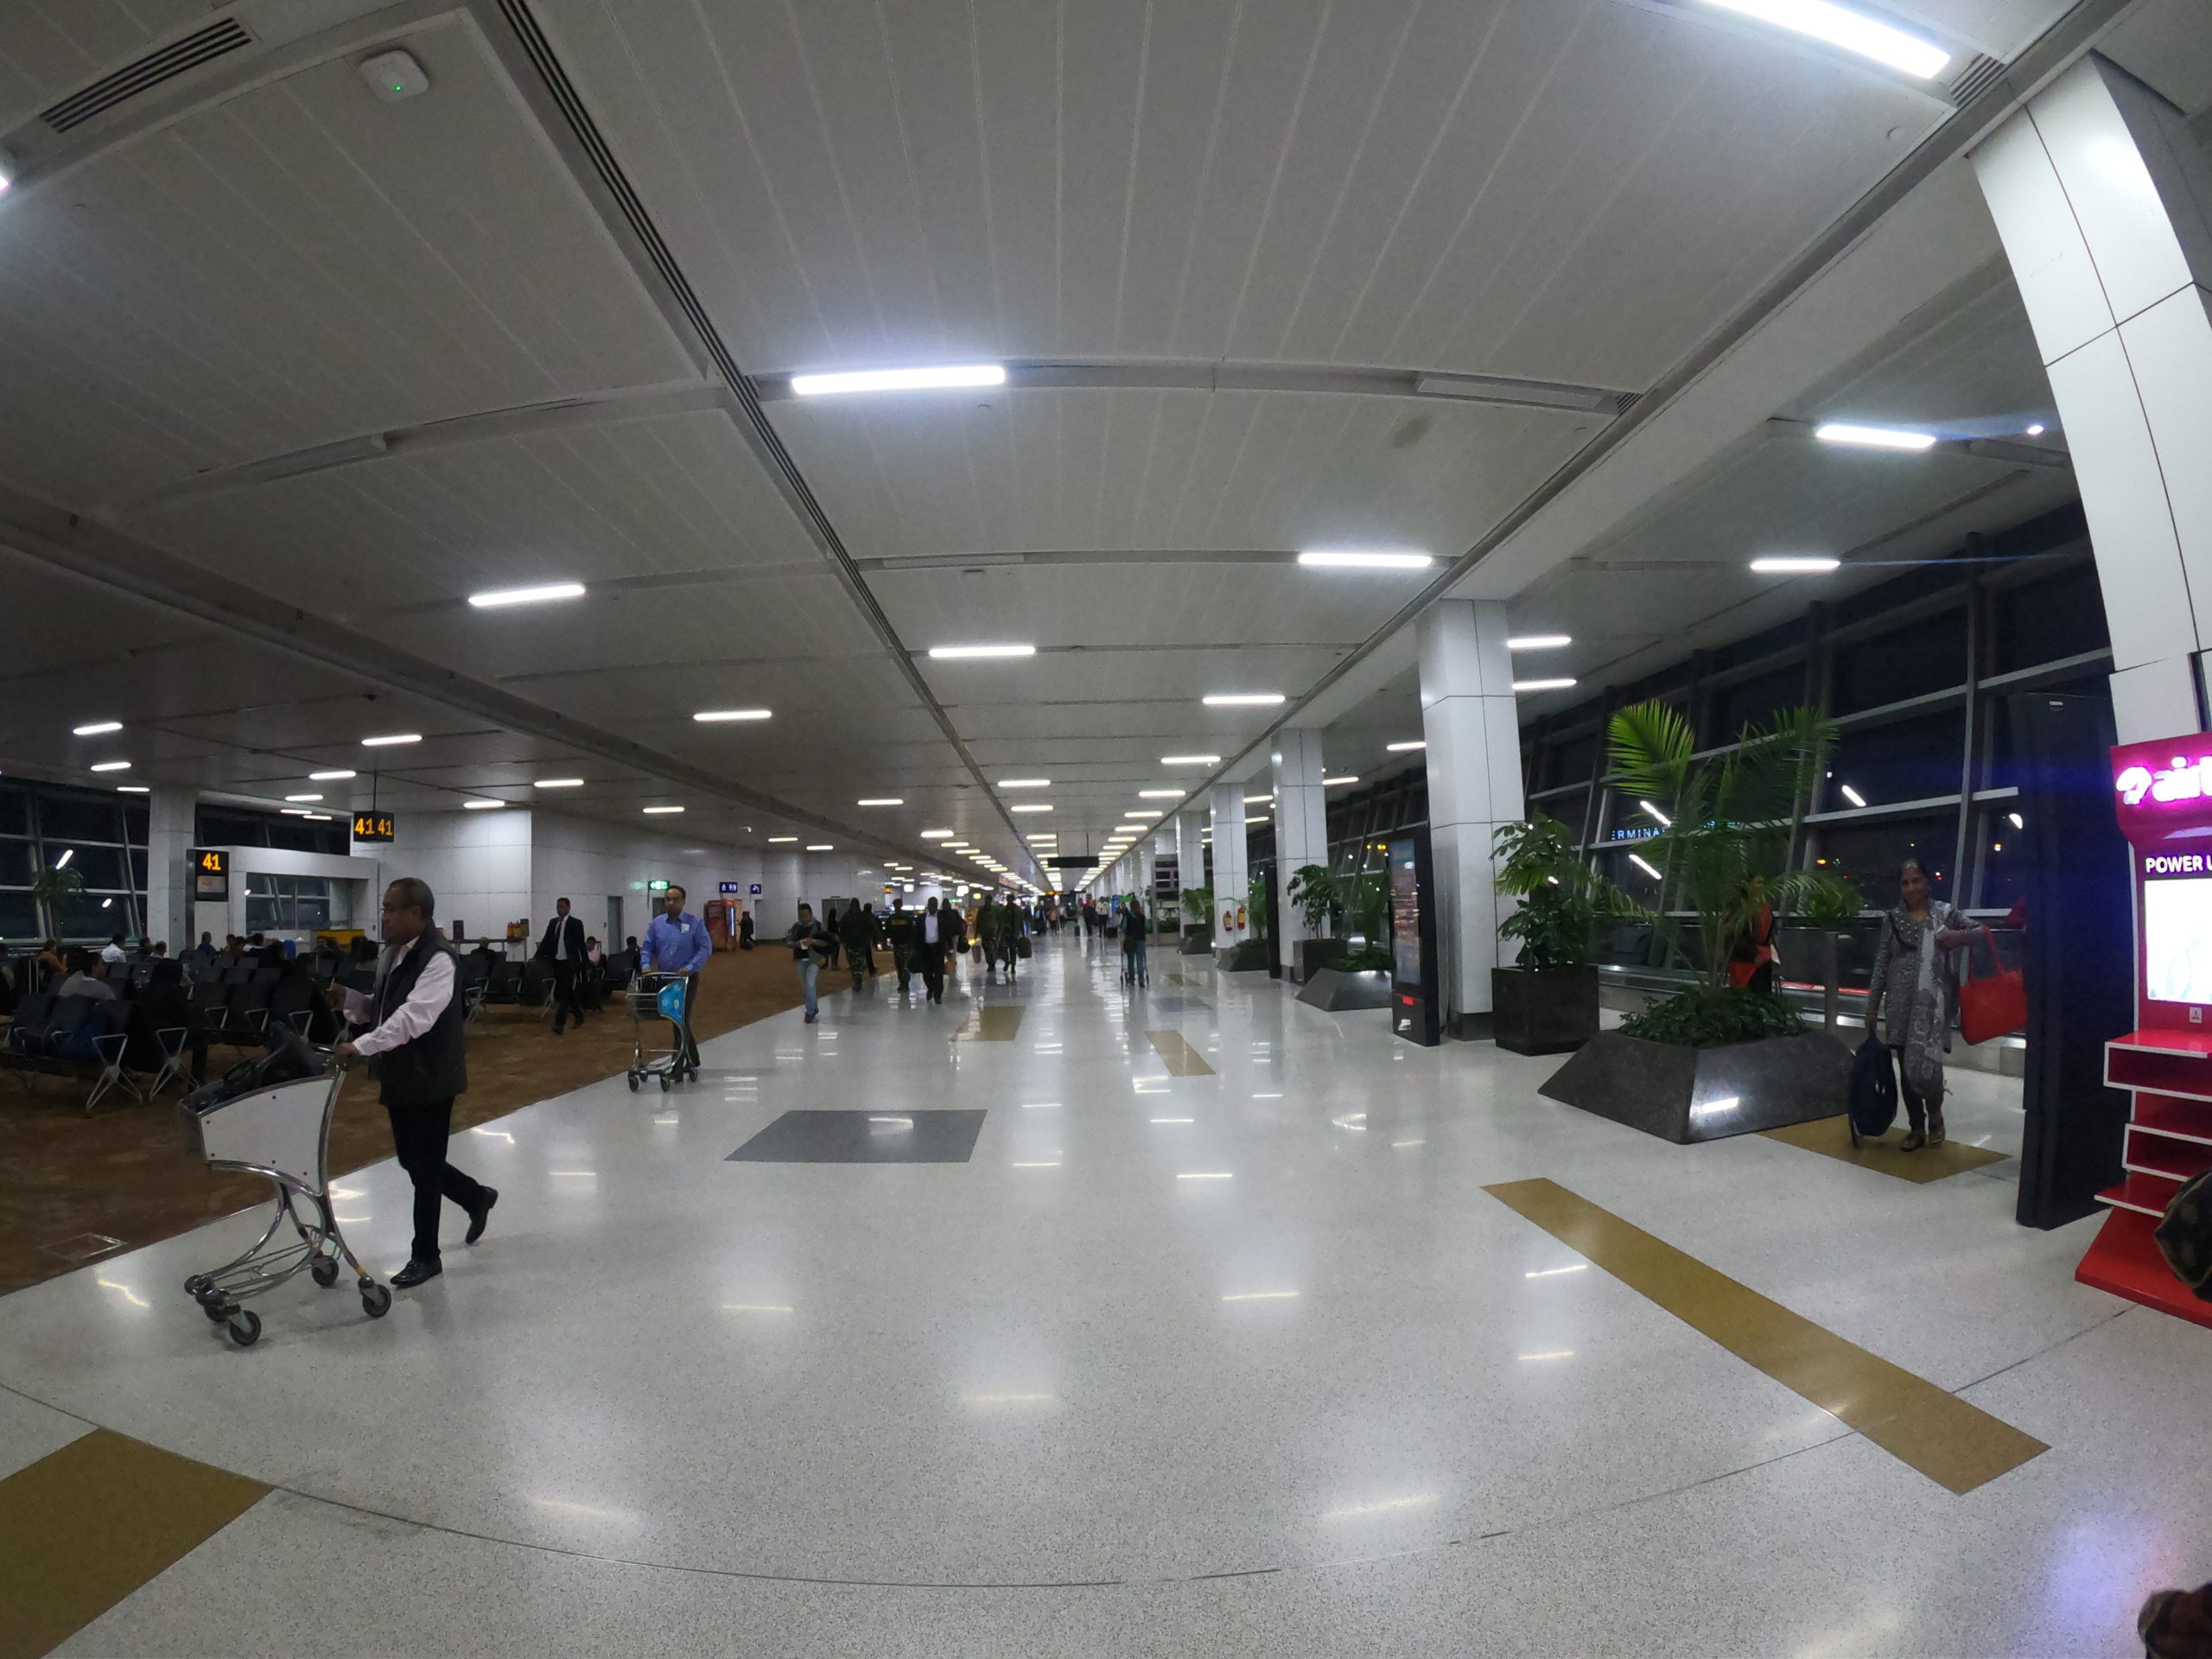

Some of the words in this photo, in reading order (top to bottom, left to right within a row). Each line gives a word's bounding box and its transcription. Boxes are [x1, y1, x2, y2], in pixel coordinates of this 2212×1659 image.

[354, 817, 375, 835] 41
[378, 817, 393, 836] 41
[202, 853, 222, 871] 41
[2145, 855, 2203, 874] POWER
